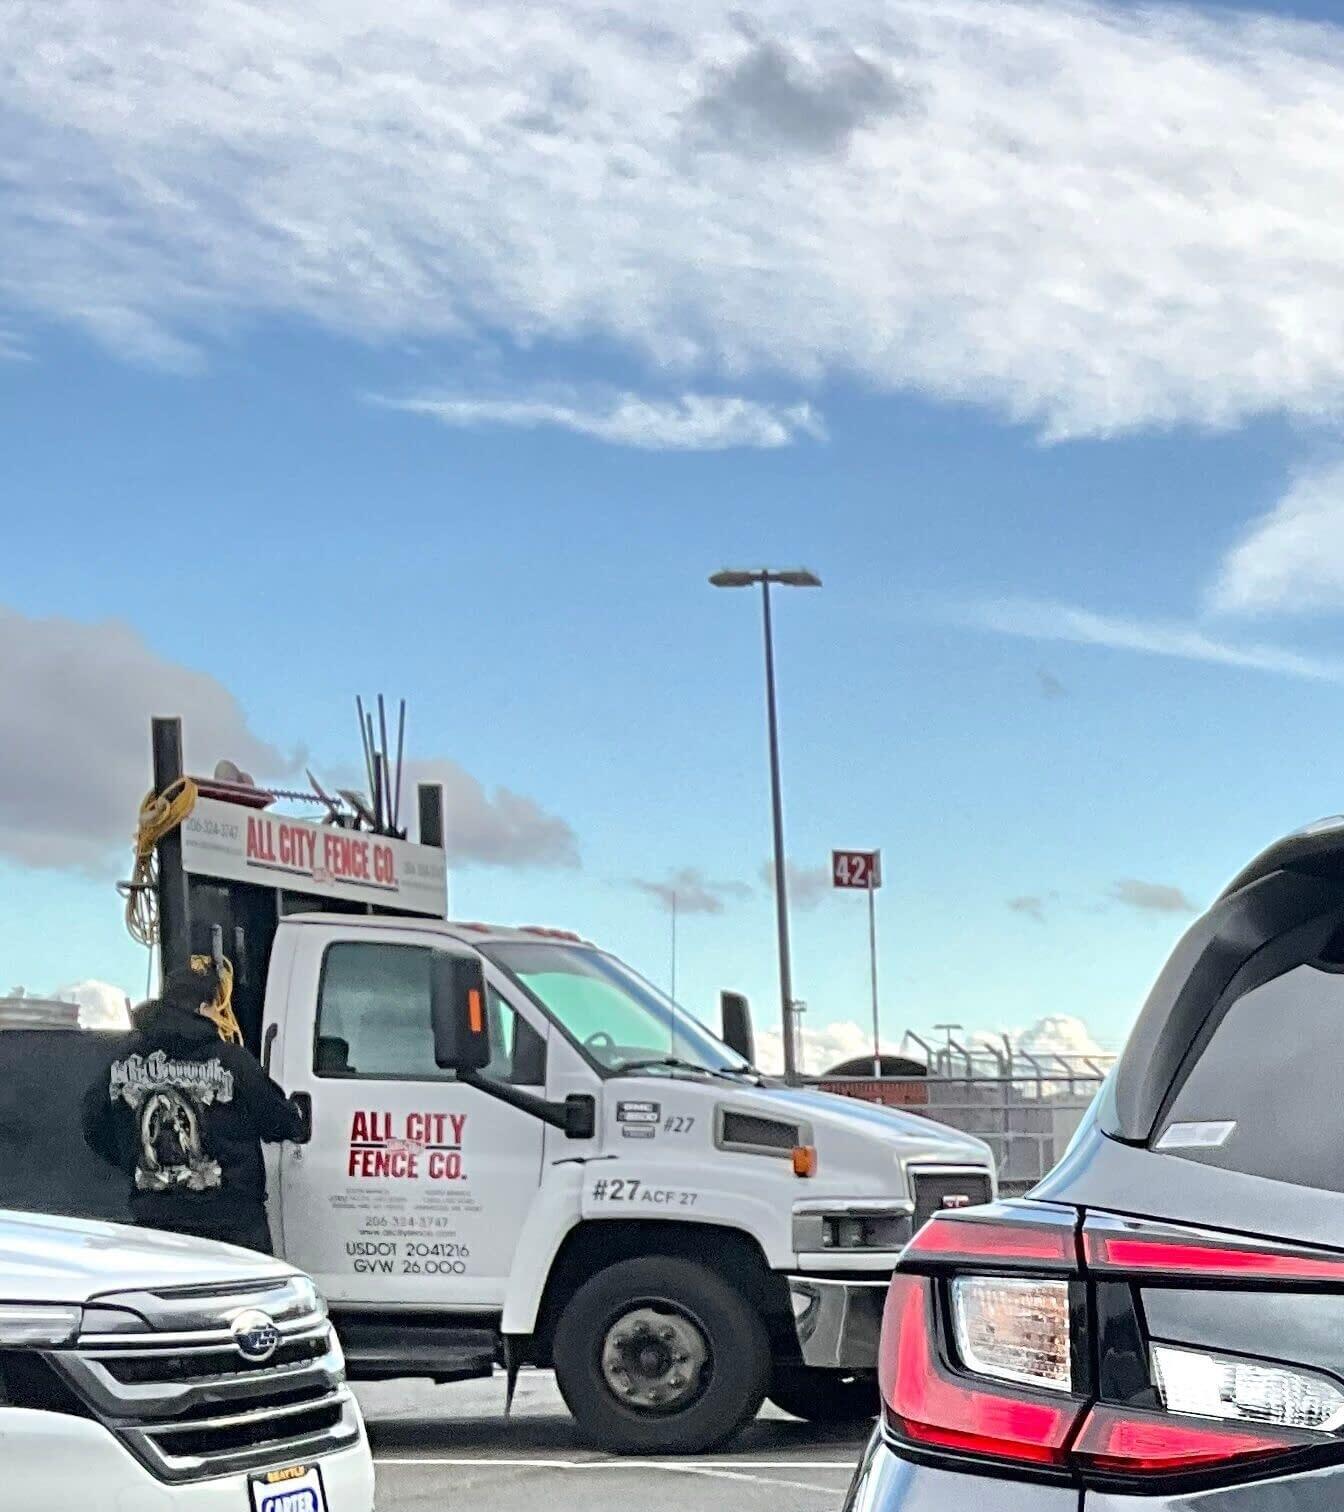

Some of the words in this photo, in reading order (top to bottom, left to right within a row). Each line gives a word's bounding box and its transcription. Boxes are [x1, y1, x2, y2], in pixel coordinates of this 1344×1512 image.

[247, 816, 276, 861] ALL
[279, 824, 317, 869] CITY
[323, 833, 370, 879] FENCE
[373, 845, 399, 885] CO.
[836, 855, 866, 885] 42
[351, 1111, 397, 1141] ALL
[406, 1112, 467, 1144] CITY
[663, 1116, 695, 1133] #27
[348, 1150, 419, 1178] FENCE
[429, 1152, 468, 1180] CO.
[593, 1179, 641, 1201] #27
[641, 1190, 675, 1204] ACF
[679, 1192, 697, 1206] 27
[346, 1242, 397, 1257] USDOT
[406, 1243, 470, 1258] 2041216
[354, 1259, 394, 1273] GVW
